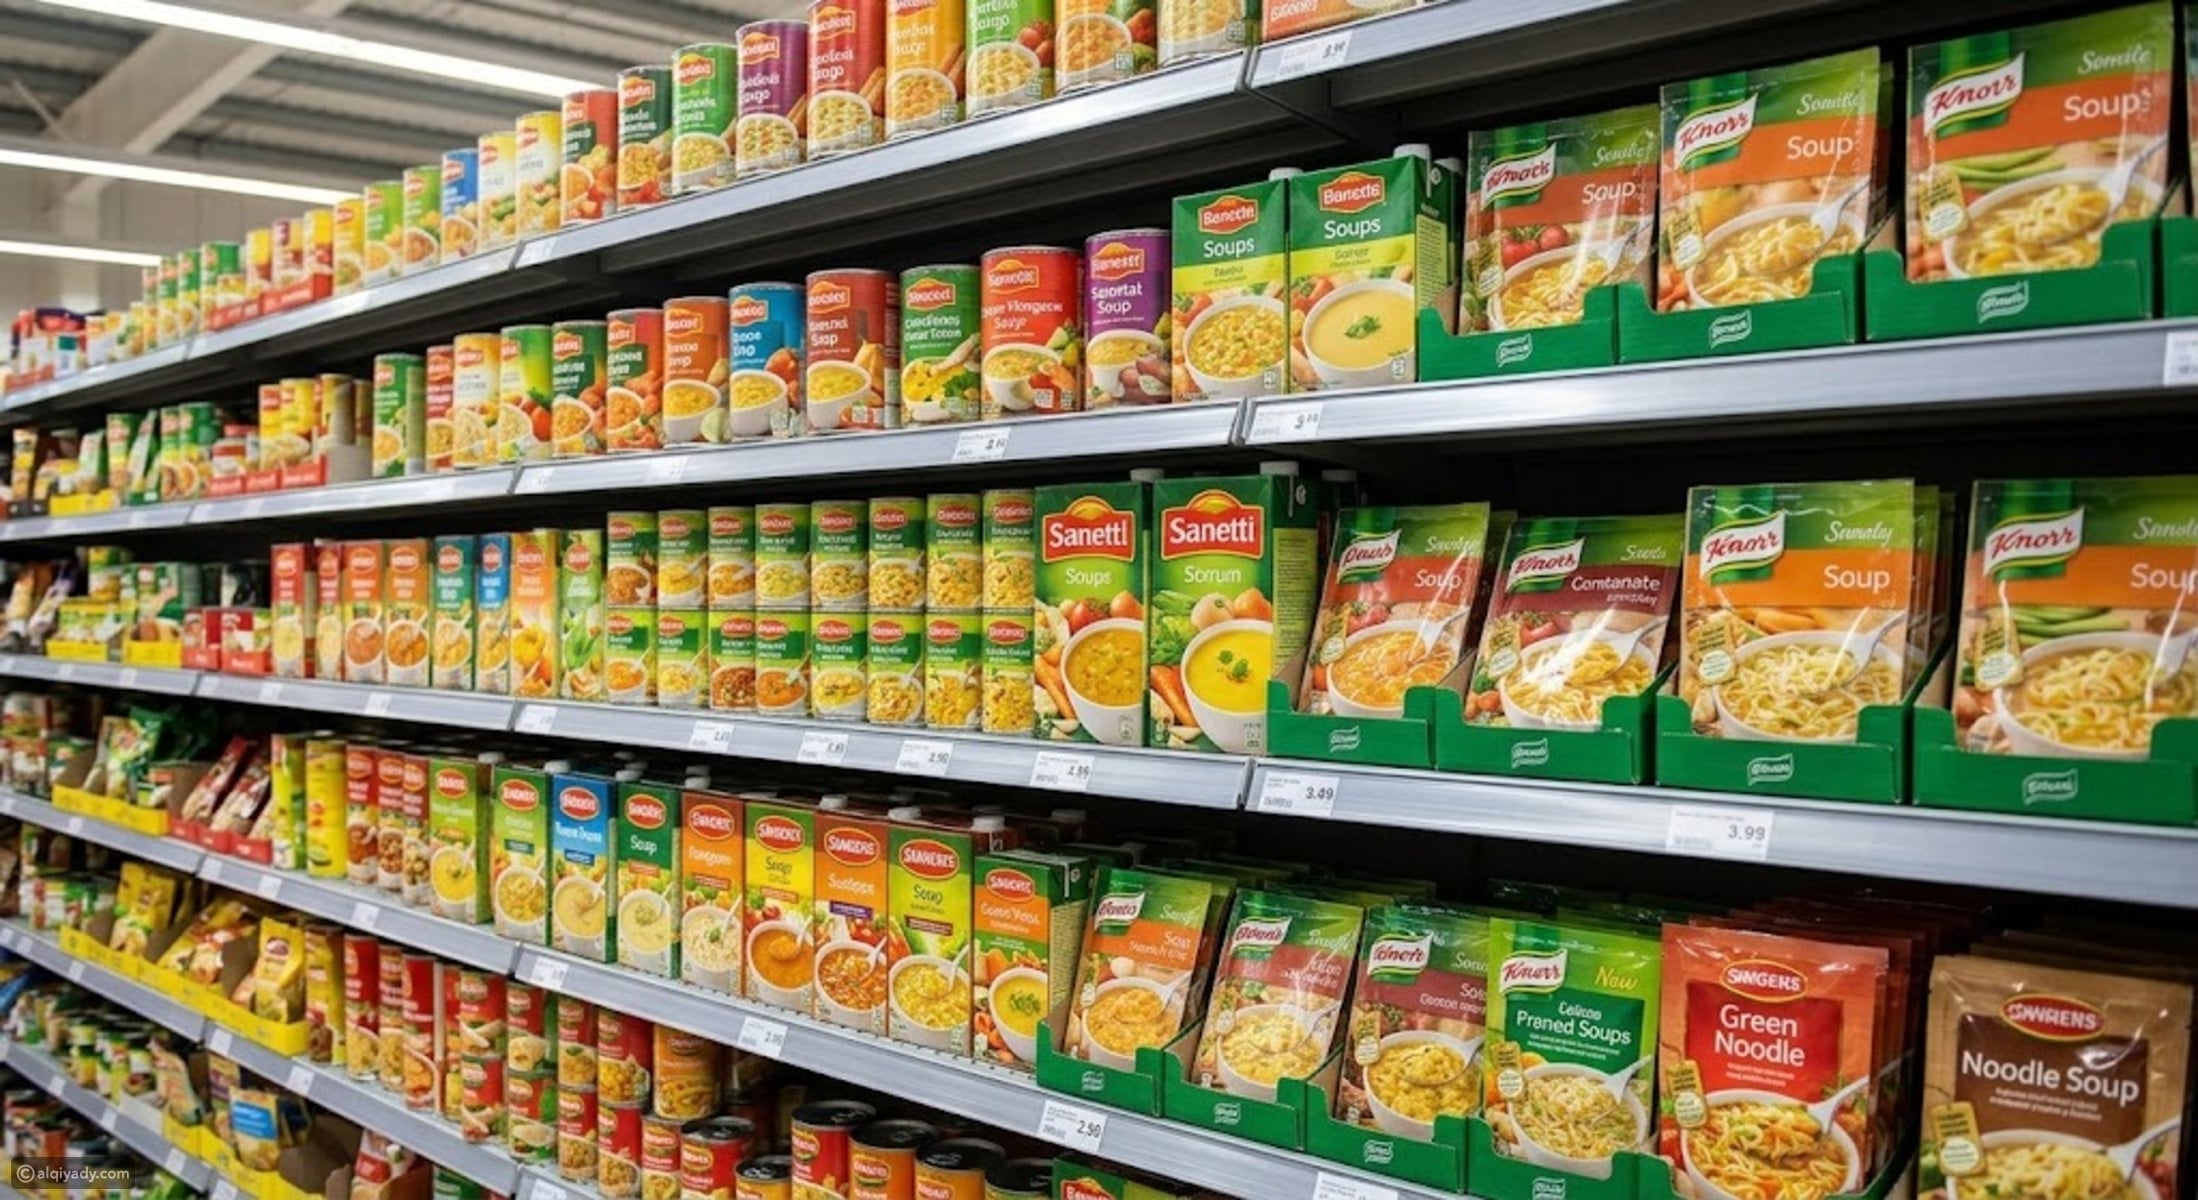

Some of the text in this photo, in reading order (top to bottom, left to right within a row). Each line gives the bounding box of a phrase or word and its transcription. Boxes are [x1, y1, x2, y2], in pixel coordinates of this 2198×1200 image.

[1786, 136, 1854, 161] Soup
[1582, 181, 1636, 205] Soup
[1323, 218, 1382, 240] Soups
[1203, 237, 1255, 258] Soups
[1169, 516, 1256, 545] Sanetti
[1989, 525, 2075, 560] Knorr
[1065, 567, 1112, 587] Soups
[1823, 564, 1891, 595] Soup
[1305, 786, 1334, 801] 3.49
[1727, 825, 1766, 841] 3.99
[1578, 1019, 1632, 1047] Soups
[1719, 1003, 1798, 1038] Green
[1714, 1030, 1806, 1067] Noodle
[1961, 1050, 2061, 1089] Noodle
[2065, 1066, 2139, 1108] Soup
